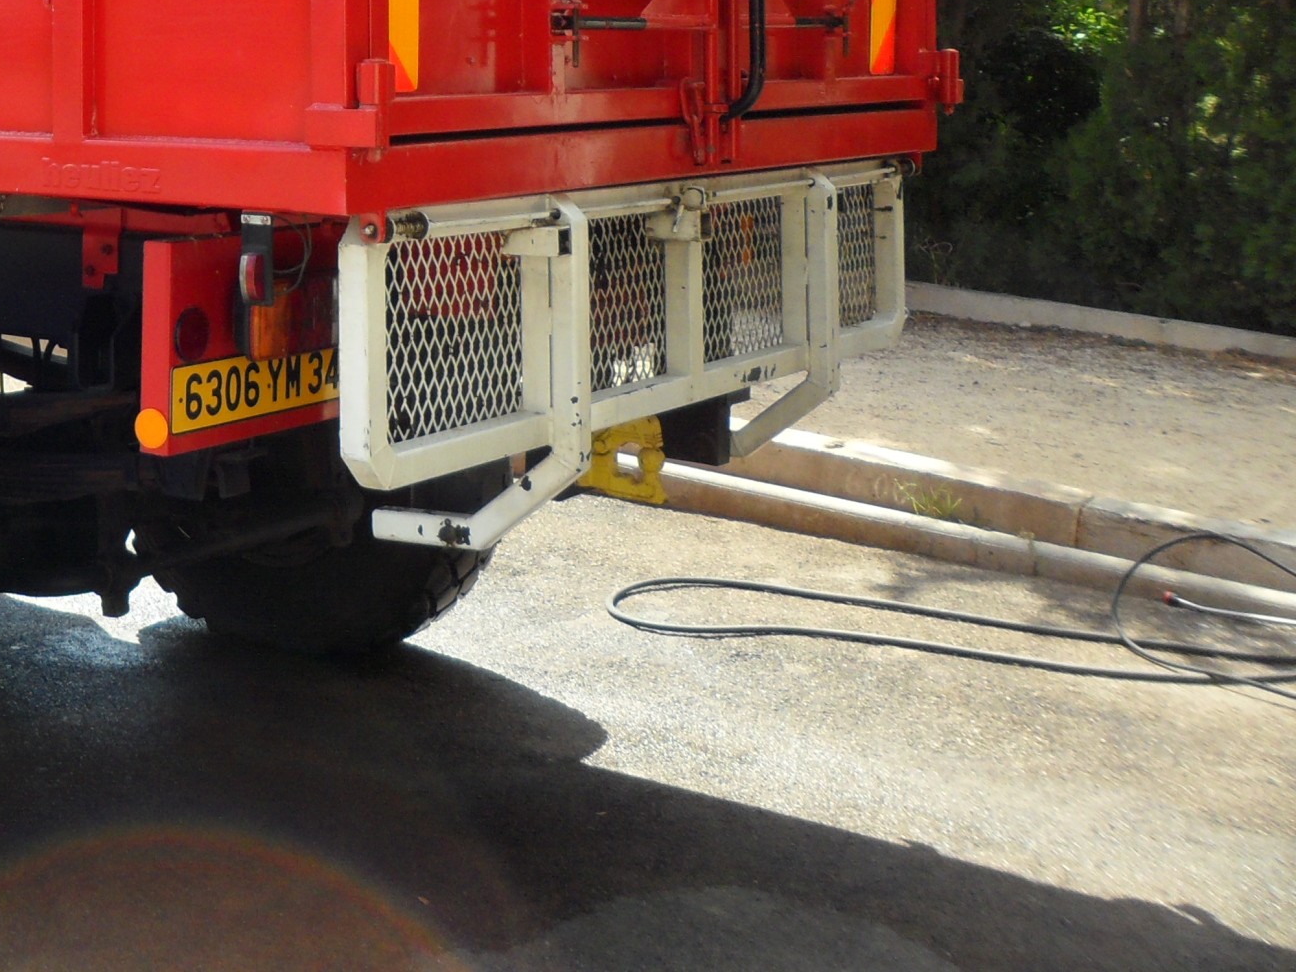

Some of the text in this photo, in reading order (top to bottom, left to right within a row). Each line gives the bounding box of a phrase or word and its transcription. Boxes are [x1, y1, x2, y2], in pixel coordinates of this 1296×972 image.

[185, 351, 340, 420] 6306 YM 34
